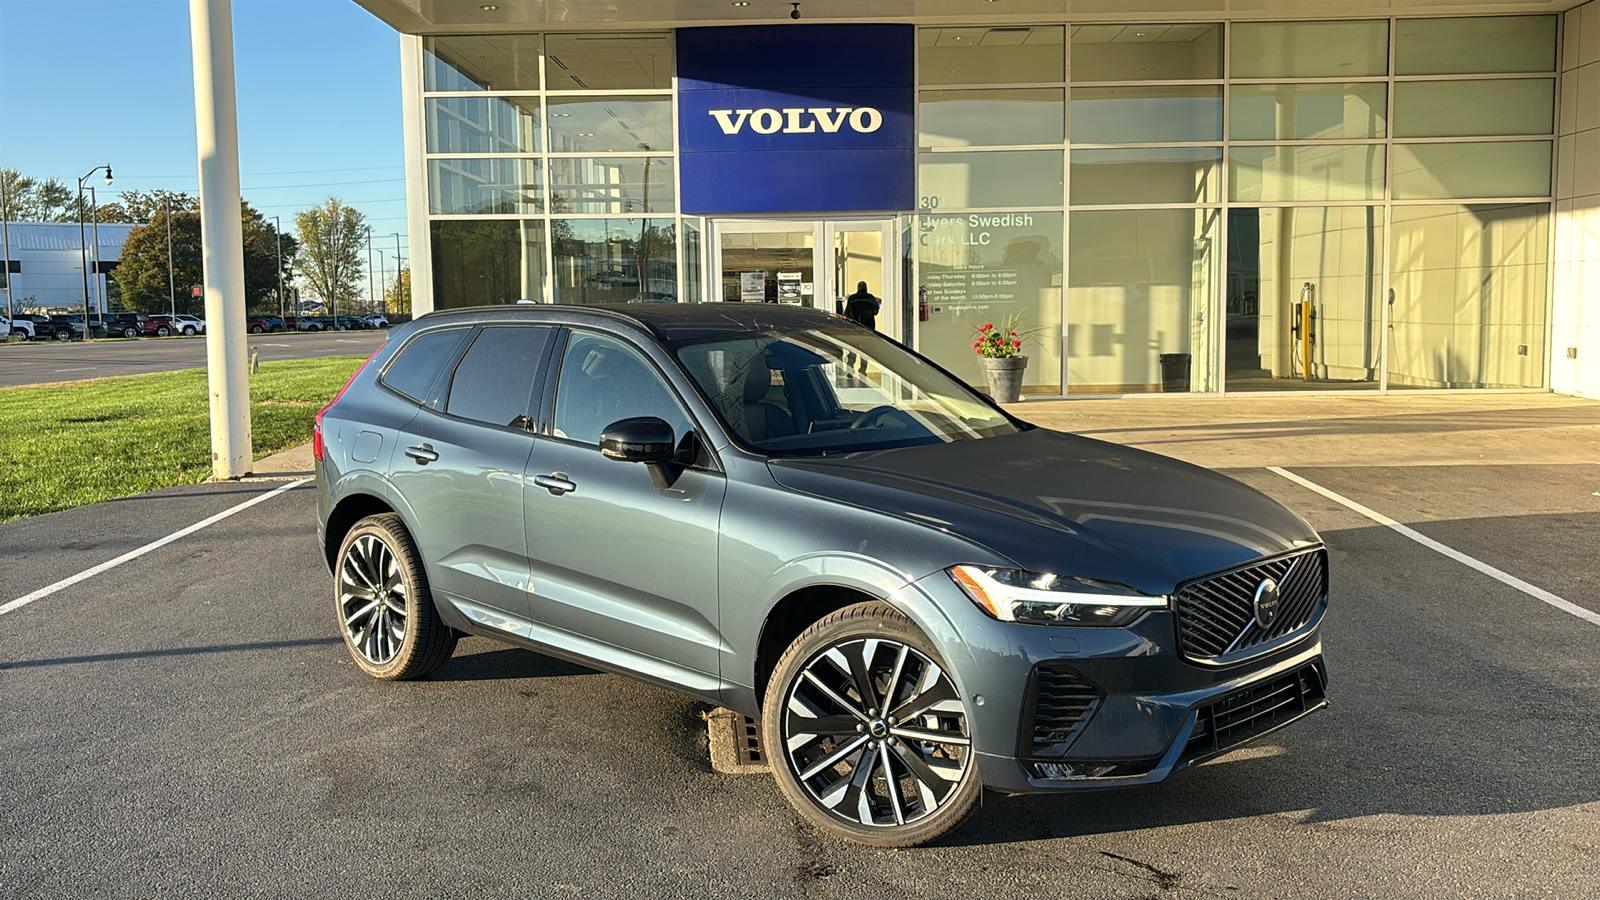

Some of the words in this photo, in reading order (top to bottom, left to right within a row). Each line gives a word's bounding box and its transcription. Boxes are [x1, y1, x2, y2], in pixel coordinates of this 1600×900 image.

[708, 107, 883, 135] VOLVO
[968, 213, 1033, 228] Swedish
[920, 233, 956, 246] Cars
[961, 232, 991, 246] LLC
